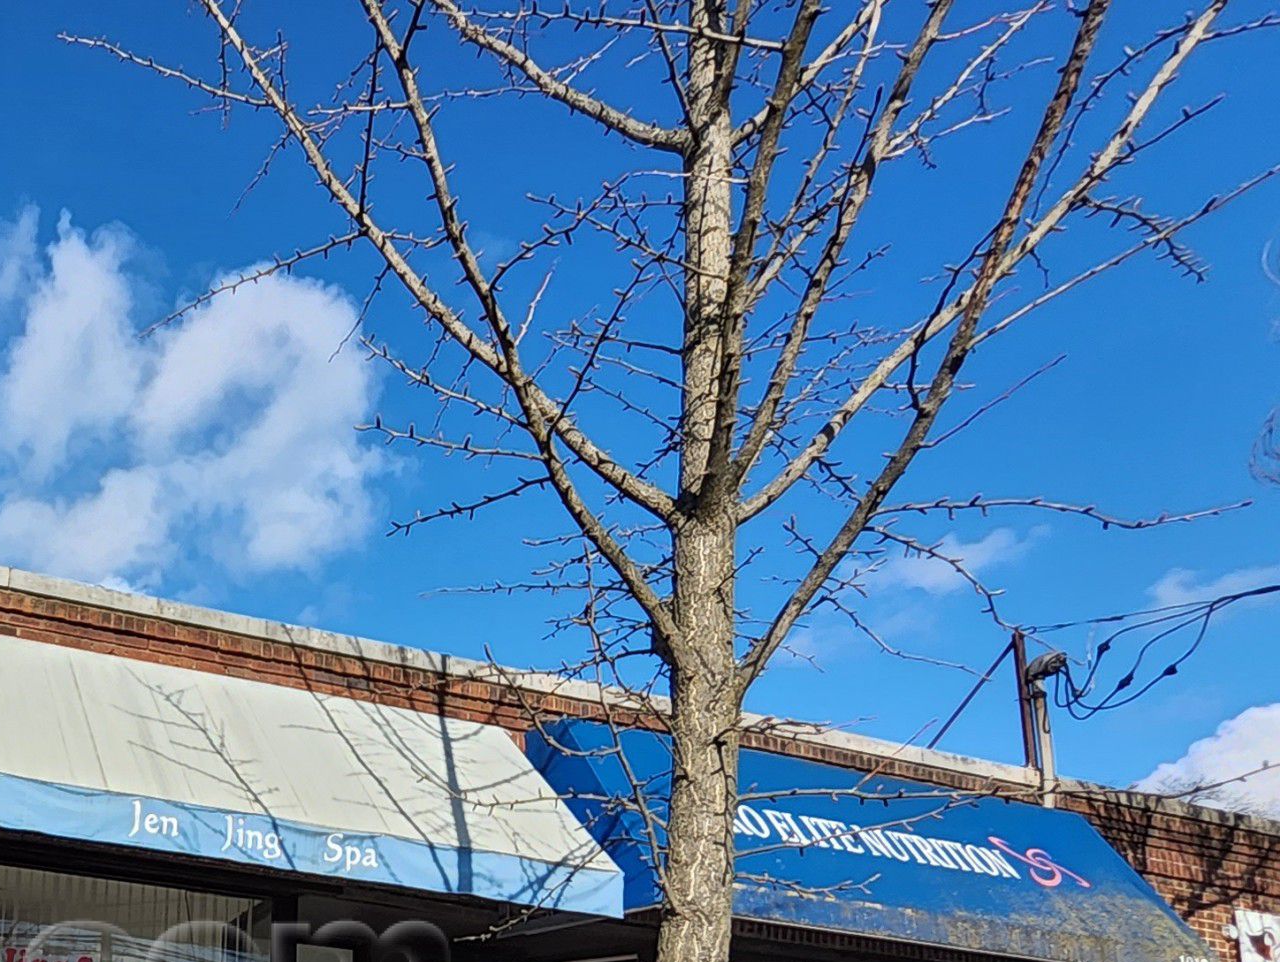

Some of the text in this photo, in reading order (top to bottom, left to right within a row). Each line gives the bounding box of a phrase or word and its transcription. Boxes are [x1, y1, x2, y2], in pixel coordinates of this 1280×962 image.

[129, 802, 379, 869] Jen Jing Spa
[764, 808, 865, 854] ELITE
[859, 825, 1021, 879] NUTRITION
